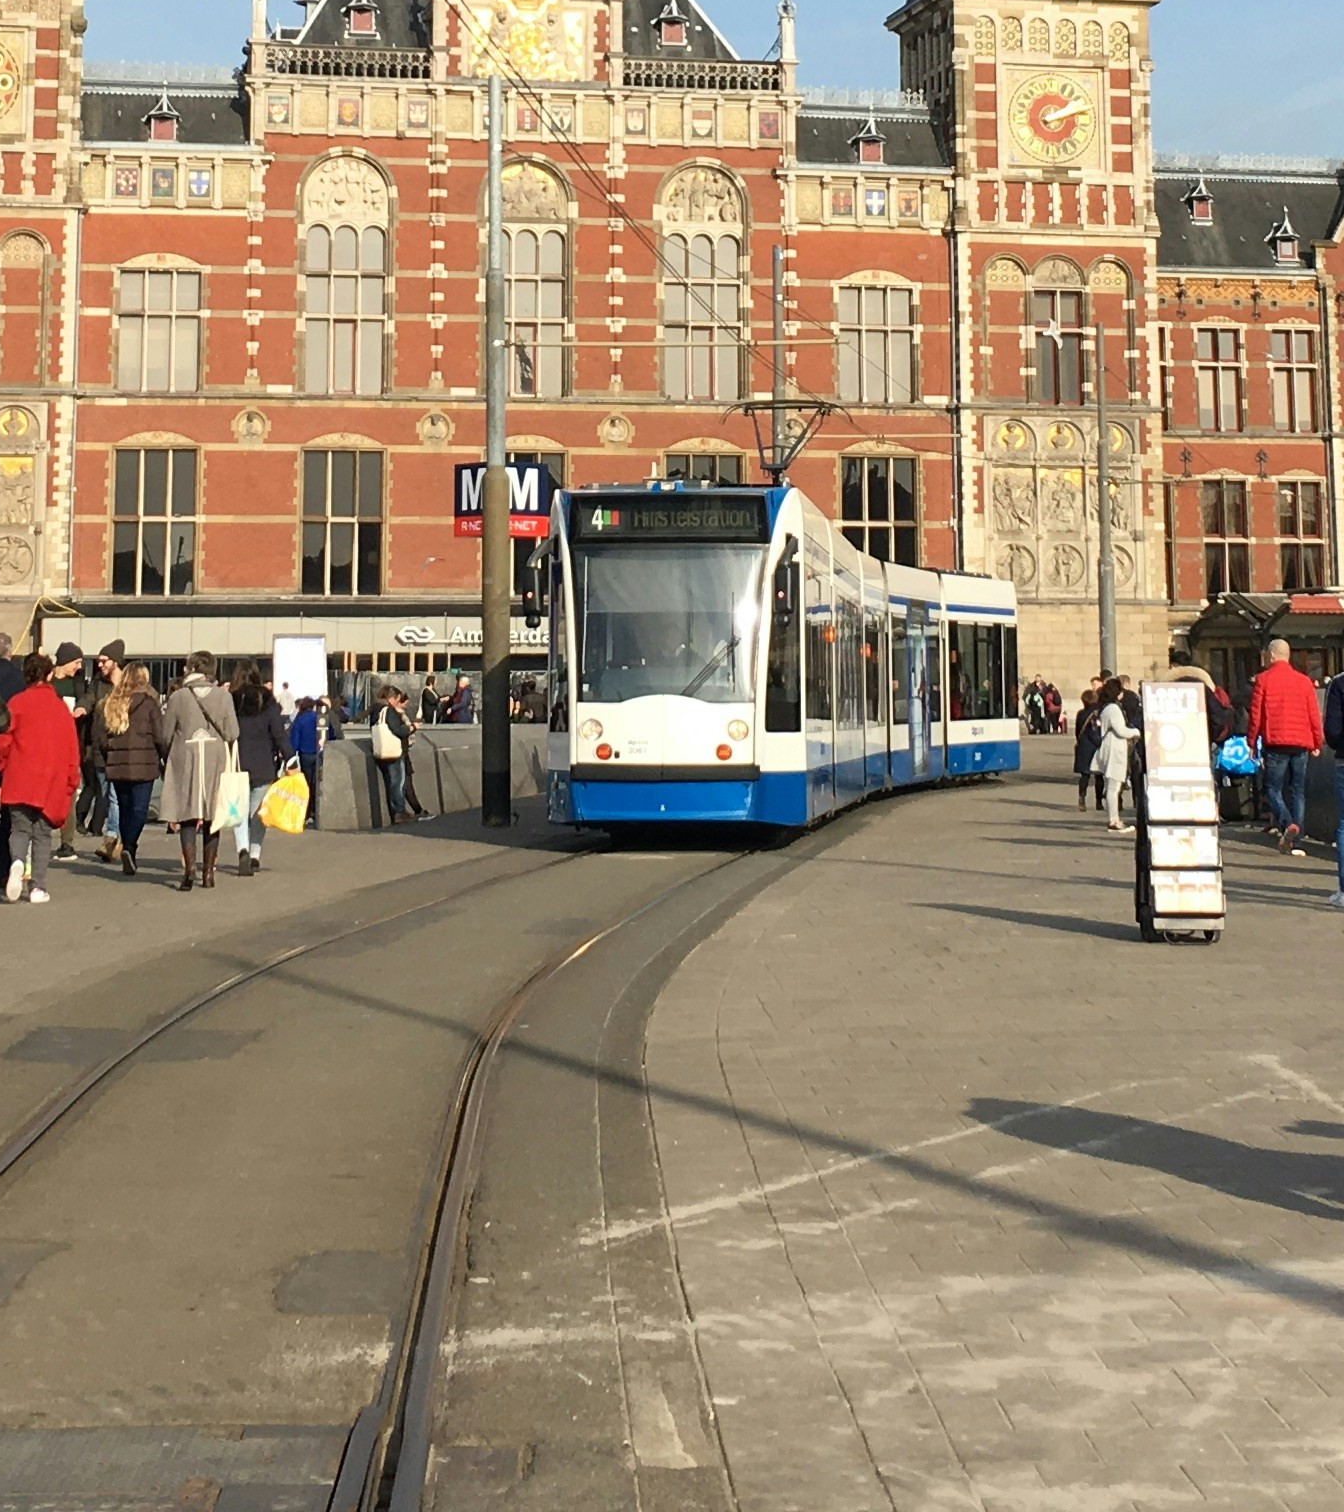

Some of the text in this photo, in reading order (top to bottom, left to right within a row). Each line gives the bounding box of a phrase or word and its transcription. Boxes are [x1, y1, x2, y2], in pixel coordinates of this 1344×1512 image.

[1063, 84, 1072, 97] I
[505, 467, 539, 511] M
[591, 505, 604, 530] 4
[461, 520, 483, 531] R-NE
[509, 520, 538, 531] -NET
[450, 626, 550, 644] Amerda
